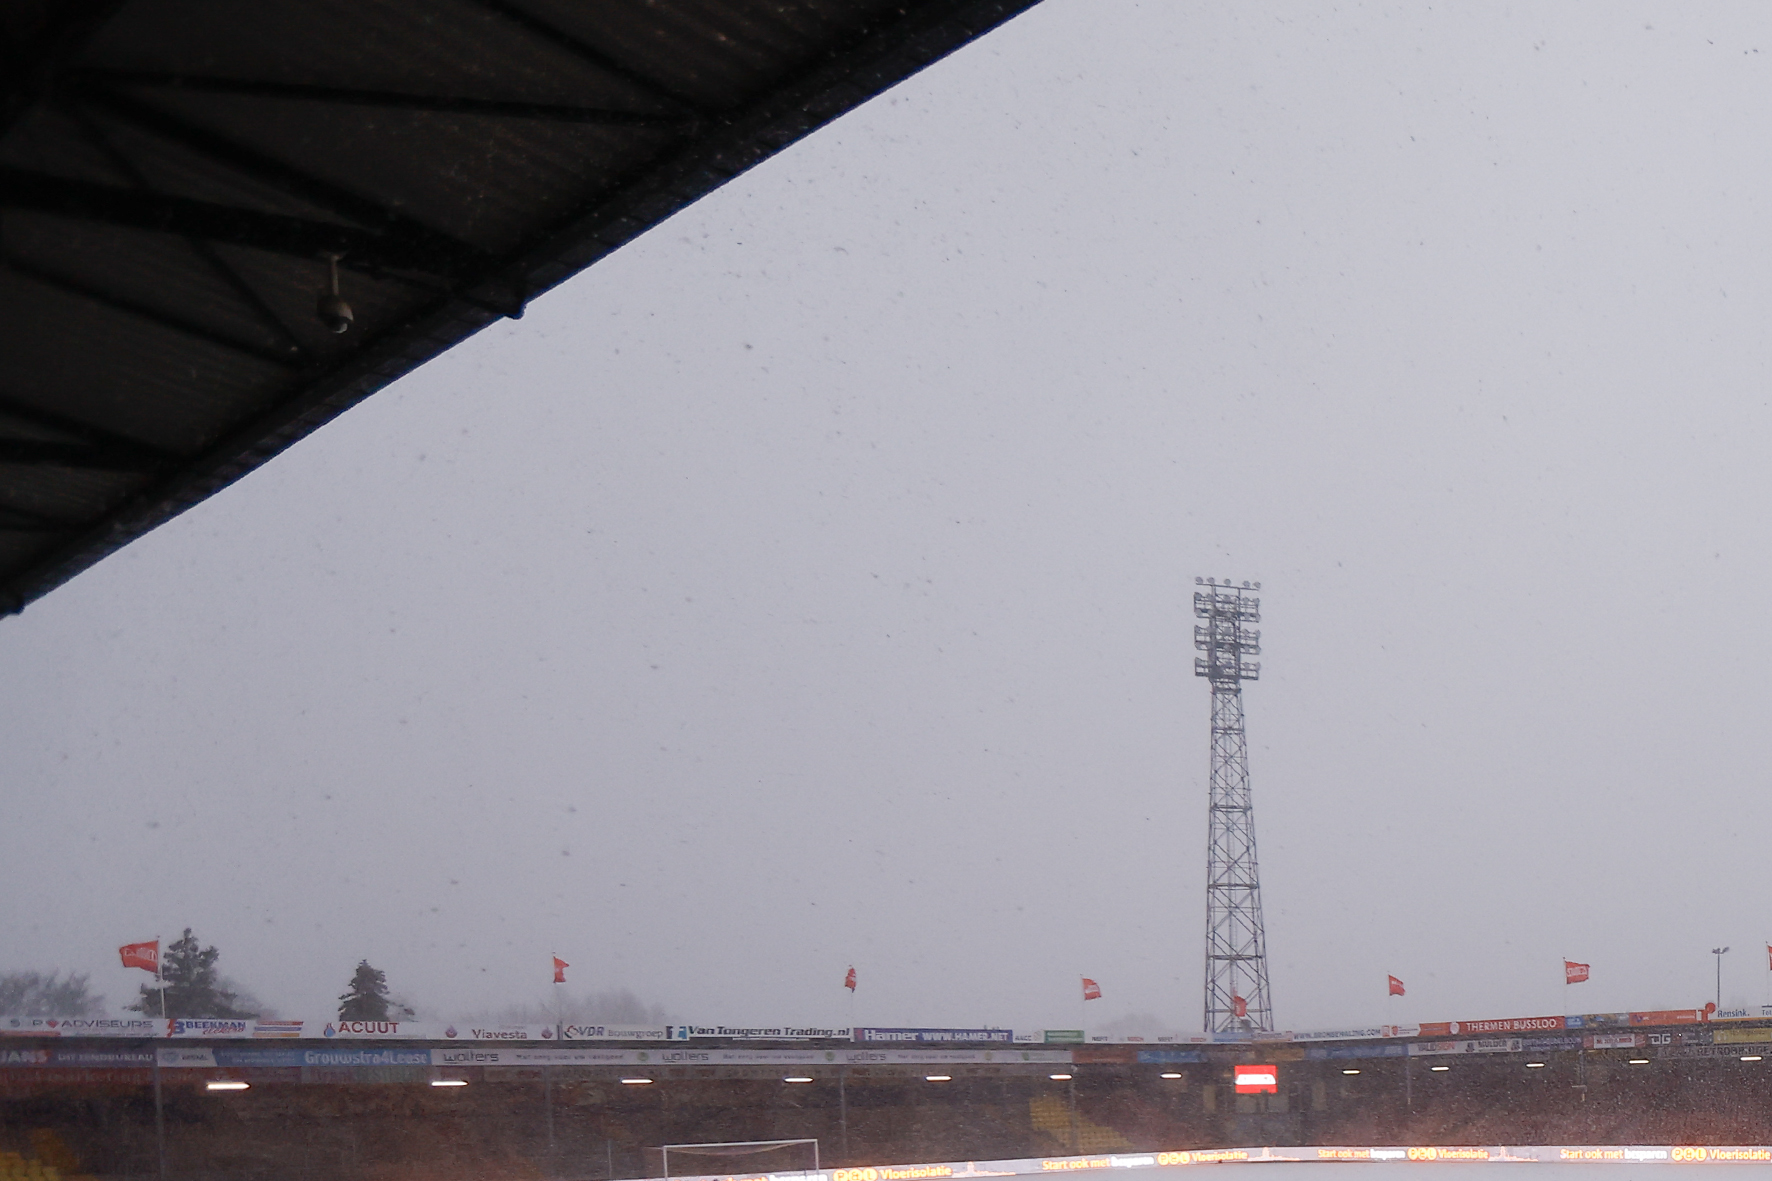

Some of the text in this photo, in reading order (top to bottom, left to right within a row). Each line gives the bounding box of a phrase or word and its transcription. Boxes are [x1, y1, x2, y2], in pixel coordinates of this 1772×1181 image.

[185, 1020, 247, 1029] BEEKMAN
[339, 1022, 399, 1034] ACUUT
[1466, 1018, 1558, 1032] THERMEN BUSSLOO
[472, 1028, 528, 1039] Viavesta
[579, 1026, 605, 1037] VDR
[688, 1026, 715, 1036] Van
[782, 1026, 850, 1039] Trading.nl
[864, 1029, 919, 1041] Hamer
[304, 1050, 428, 1064] Grouwstra4Lease
[1318, 1149, 1337, 1159] Start
[1338, 1149, 1352, 1159] ook
[1353, 1149, 1370, 1159] met
[1438, 1148, 1489, 1160] Vloerisolatie
[1560, 1148, 1584, 1160] Start
[1585, 1148, 1603, 1159] ook
[1604, 1148, 1624, 1159] met
[1709, 1148, 1772, 1160] Vloerisolatie
[1042, 1159, 1068, 1171] Start
[1069, 1157, 1087, 1169] ook
[1088, 1157, 1110, 1168] met
[1192, 1150, 1248, 1163] Vloerisolatie
[879, 1166, 953, 1181] Vloerisolatie
